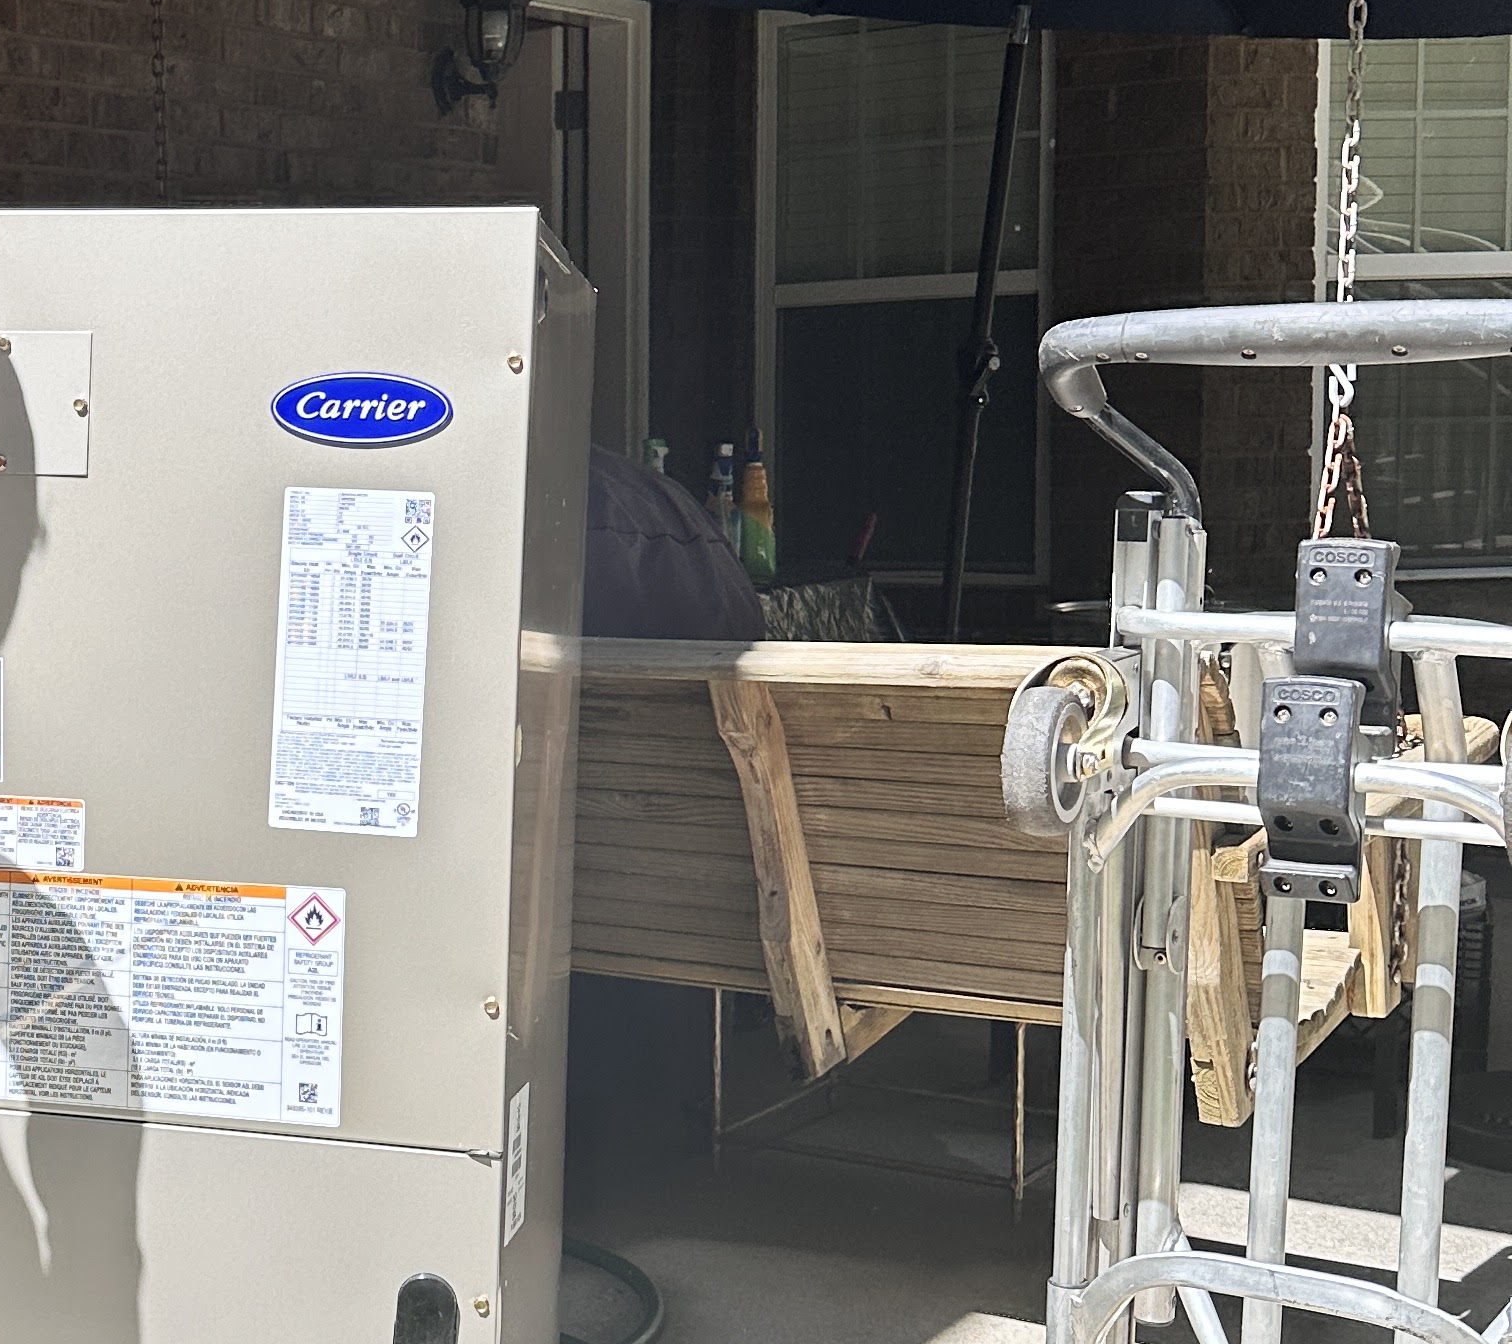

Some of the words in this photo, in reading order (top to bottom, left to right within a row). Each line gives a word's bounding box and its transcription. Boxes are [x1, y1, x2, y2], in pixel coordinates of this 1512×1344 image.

[297, 391, 426, 420] Carrier
[1314, 551, 1369, 564] COSCO
[1278, 688, 1335, 702] COSCO
